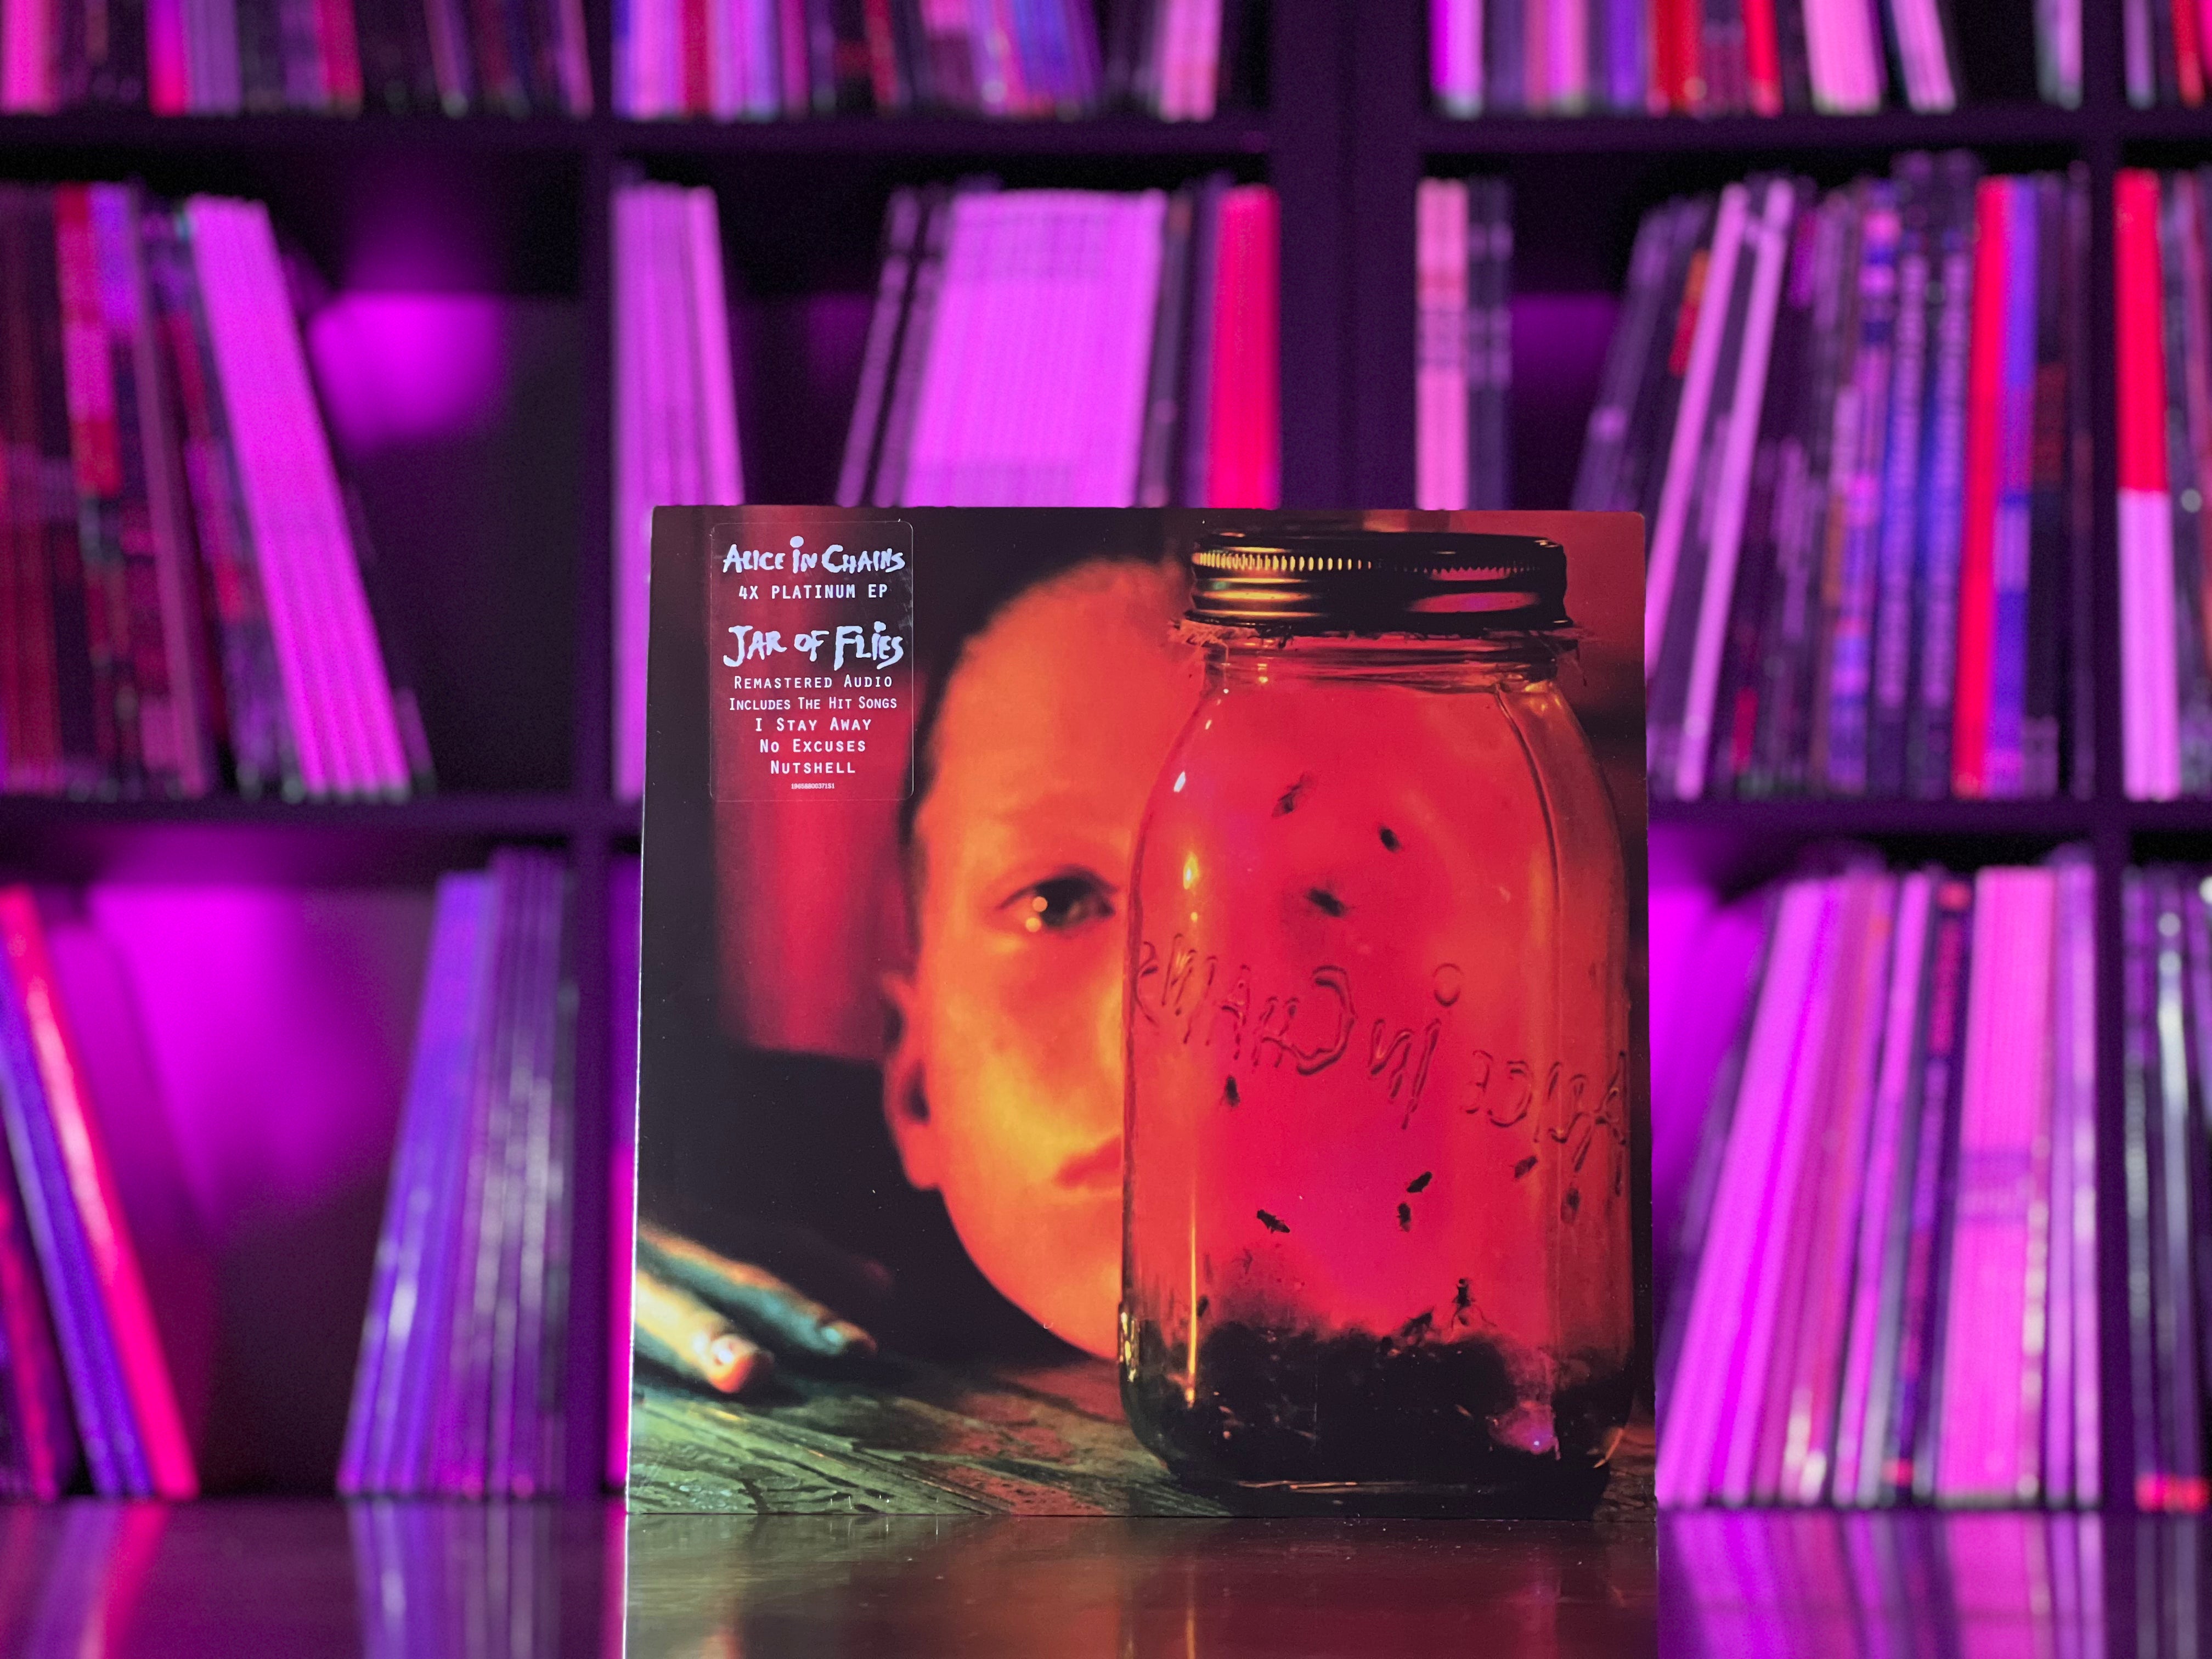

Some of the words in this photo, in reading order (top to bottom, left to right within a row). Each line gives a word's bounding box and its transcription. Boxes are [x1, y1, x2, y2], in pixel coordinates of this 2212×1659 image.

[822, 544, 905, 574] CHAINS
[739, 585, 759, 600] 4X
[771, 584, 856, 599] PLATINUM
[868, 584, 888, 598] EP
[755, 718, 762, 732] I
[770, 760, 855, 774] NUTSHELL
